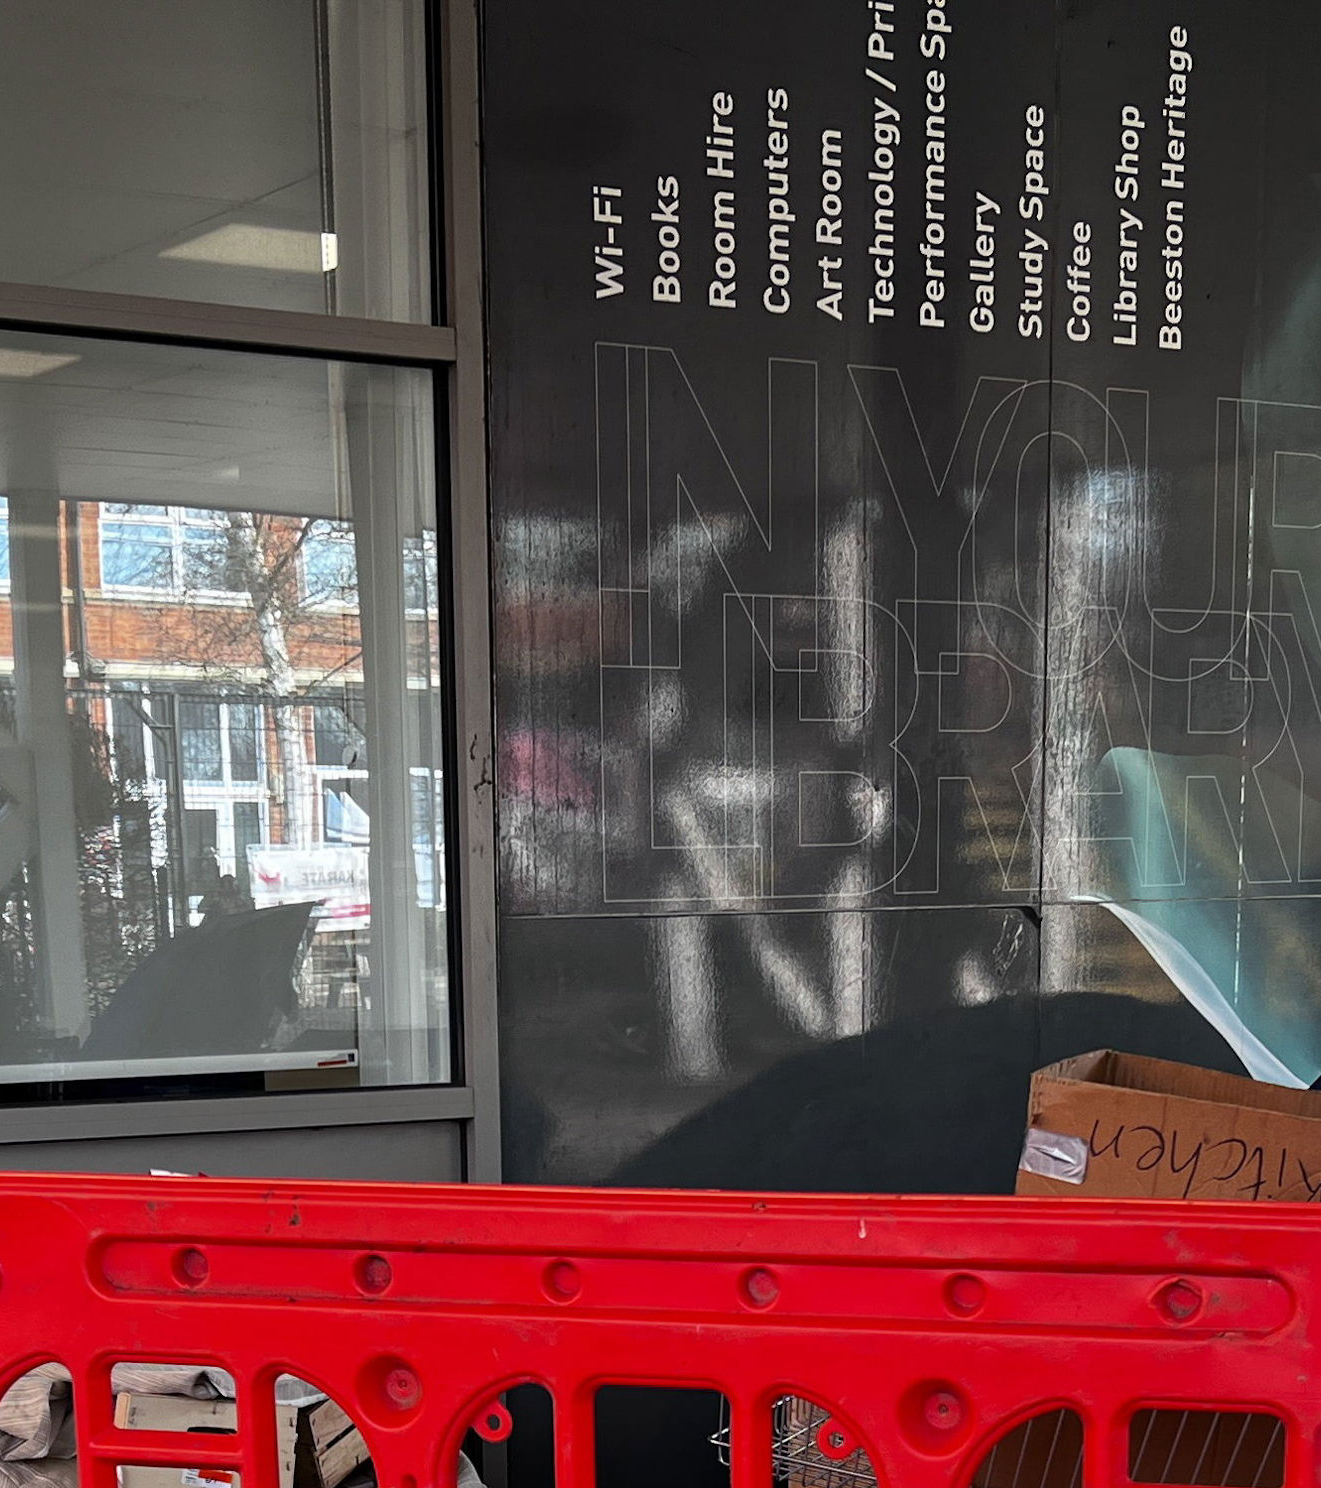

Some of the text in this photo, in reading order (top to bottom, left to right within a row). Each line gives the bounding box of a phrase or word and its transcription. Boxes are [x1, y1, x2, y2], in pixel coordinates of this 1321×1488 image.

[867, 0, 895, 61] Pri
[593, 186, 624, 299] Wi-Fi
[650, 176, 681, 303] Books
[706, 91, 737, 308] Room Hire
[763, 88, 796, 314] Computers
[815, 129, 843, 321] Art Room
[867, 97, 901, 324] Technology
[919, 70, 946, 328] Performance
[969, 191, 1001, 333] Gallery
[1017, 105, 1050, 339] Study Space
[1066, 221, 1092, 342] Coffee
[1113, 105, 1146, 346] Library Shop
[1158, 25, 1193, 350] Beeston Heritage
